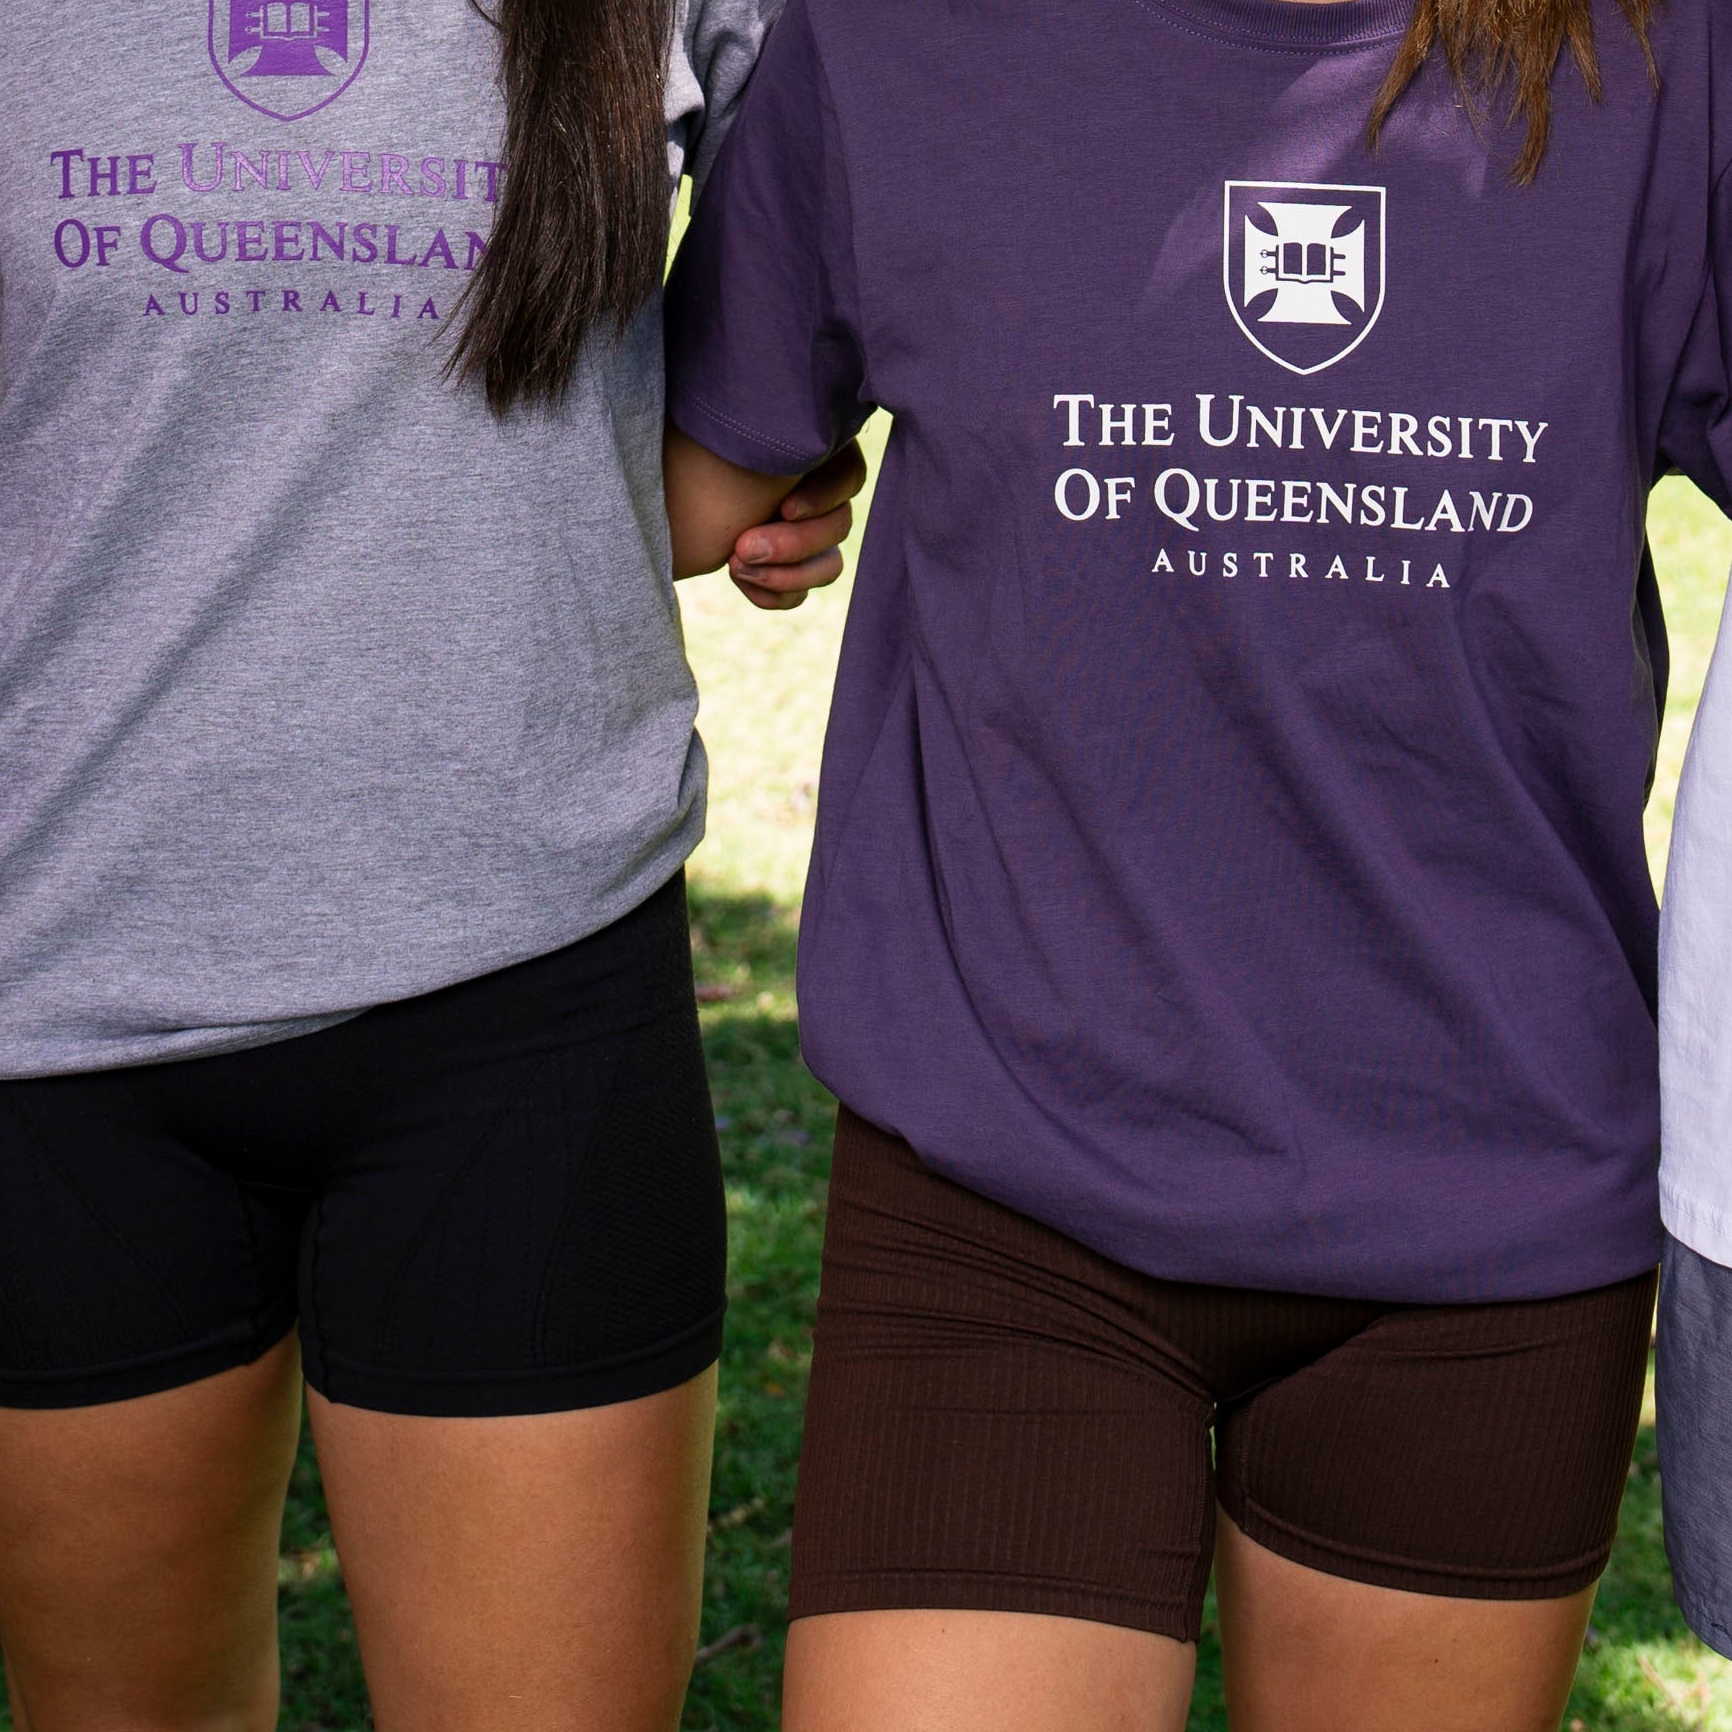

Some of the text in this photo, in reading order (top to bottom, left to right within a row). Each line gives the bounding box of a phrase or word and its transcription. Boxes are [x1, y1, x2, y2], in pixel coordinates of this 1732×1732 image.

[50, 142, 510, 202] THE UNIVERSIT
[53, 218, 121, 268] OF
[143, 290, 440, 320] AUSTRALIA
[1053, 394, 1548, 464] THE UNIVERSITY
[1054, 468, 1533, 533] OF QUEENSLAND
[1151, 548, 1451, 588] AUSTRALIA
